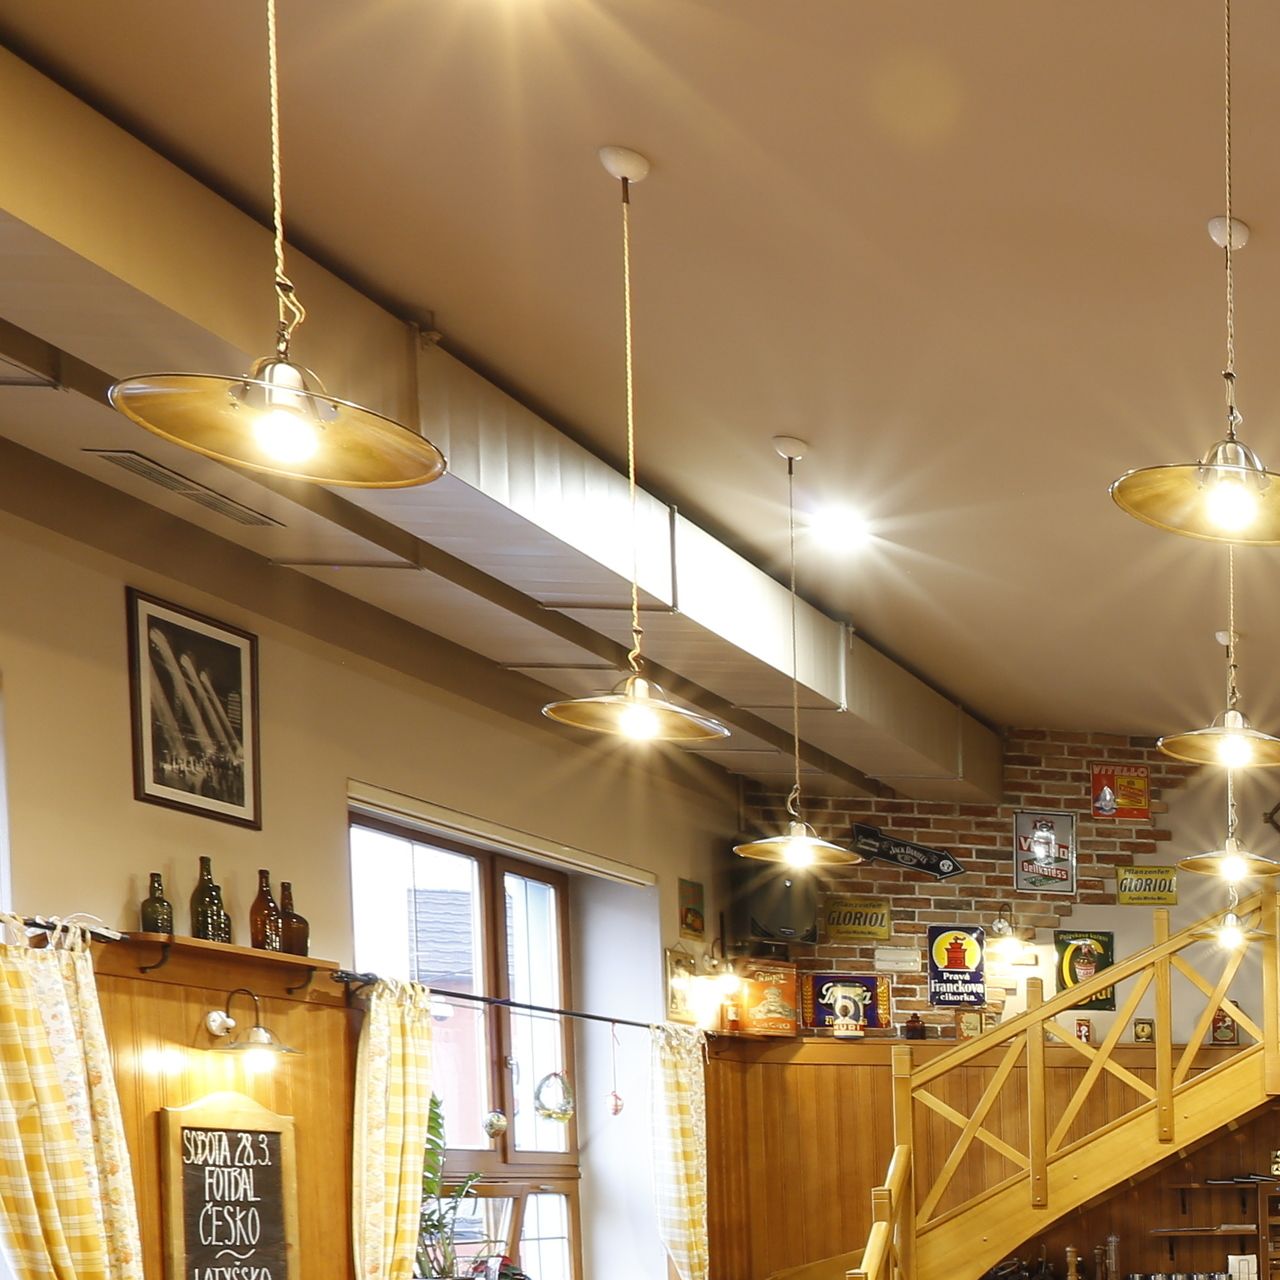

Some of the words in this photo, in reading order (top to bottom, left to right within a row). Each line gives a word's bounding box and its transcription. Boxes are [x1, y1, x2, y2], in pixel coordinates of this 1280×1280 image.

[1092, 764, 1148, 777] VITELLO
[1023, 862, 1067, 880] Delikatess
[1120, 877, 1174, 893] GLORIOL
[828, 910, 886, 928] GLORIOL
[943, 972, 970, 980] Pravá
[931, 979, 984, 993] Franckova
[183, 1129, 231, 1166] SOBOTA
[205, 1167, 261, 1201] FOTBAL
[199, 1202, 260, 1246] ČESKO
